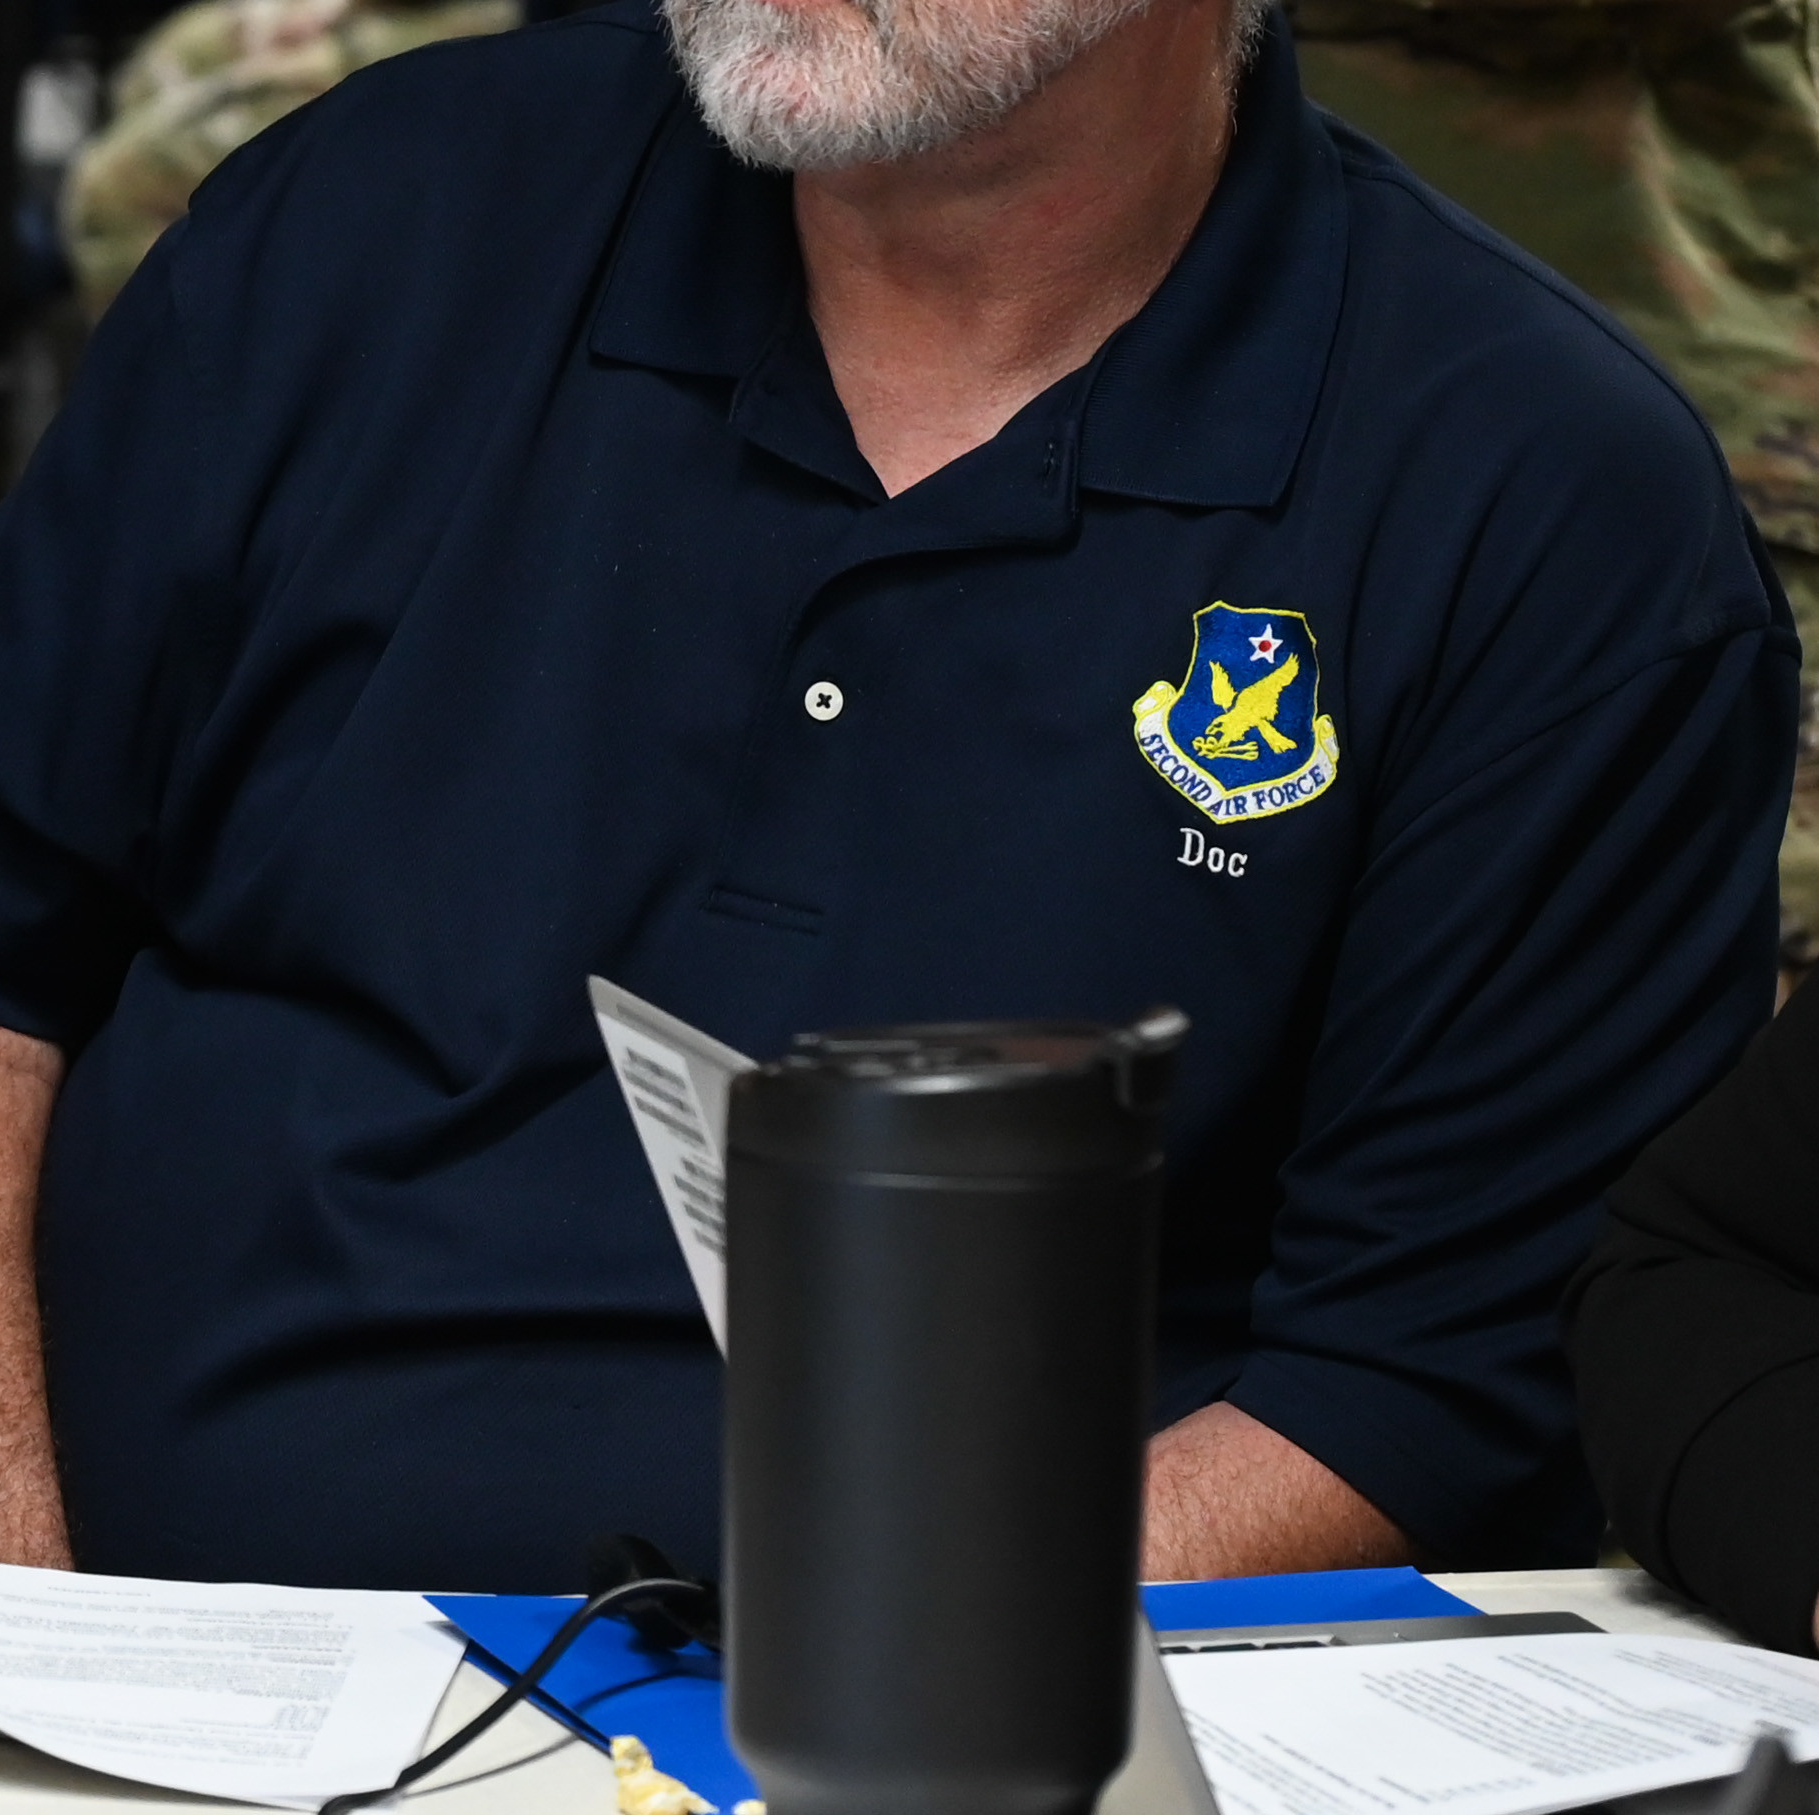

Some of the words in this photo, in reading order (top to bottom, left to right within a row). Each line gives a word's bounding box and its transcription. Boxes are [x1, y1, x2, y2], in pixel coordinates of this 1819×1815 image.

[1139, 733, 1212, 802] SECOND
[1208, 795, 1249, 816] AIR
[1252, 765, 1326, 810] FORCE
[1177, 827, 1248, 877] Doc
